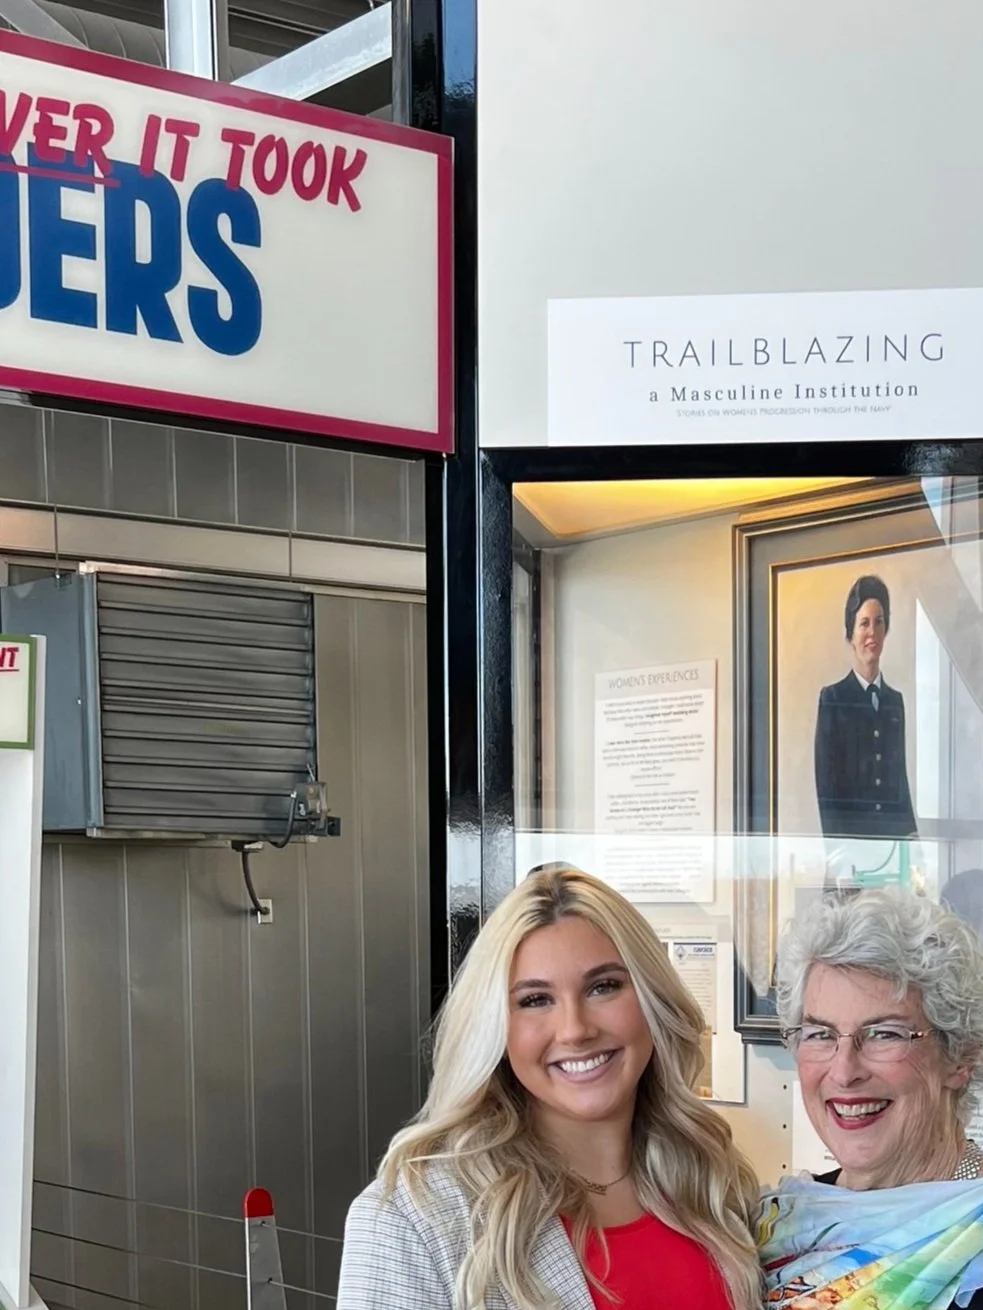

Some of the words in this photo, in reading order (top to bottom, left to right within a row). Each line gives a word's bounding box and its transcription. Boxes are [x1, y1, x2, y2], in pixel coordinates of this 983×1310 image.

[139, 114, 200, 183] IT
[221, 127, 367, 213] TOOK
[623, 332, 945, 368] TRAILBLAZING
[648, 388, 659, 402] a
[671, 384, 783, 402] Masculine
[795, 381, 919, 400] Institution
[648, 668, 700, 686] EXPERIENCES
